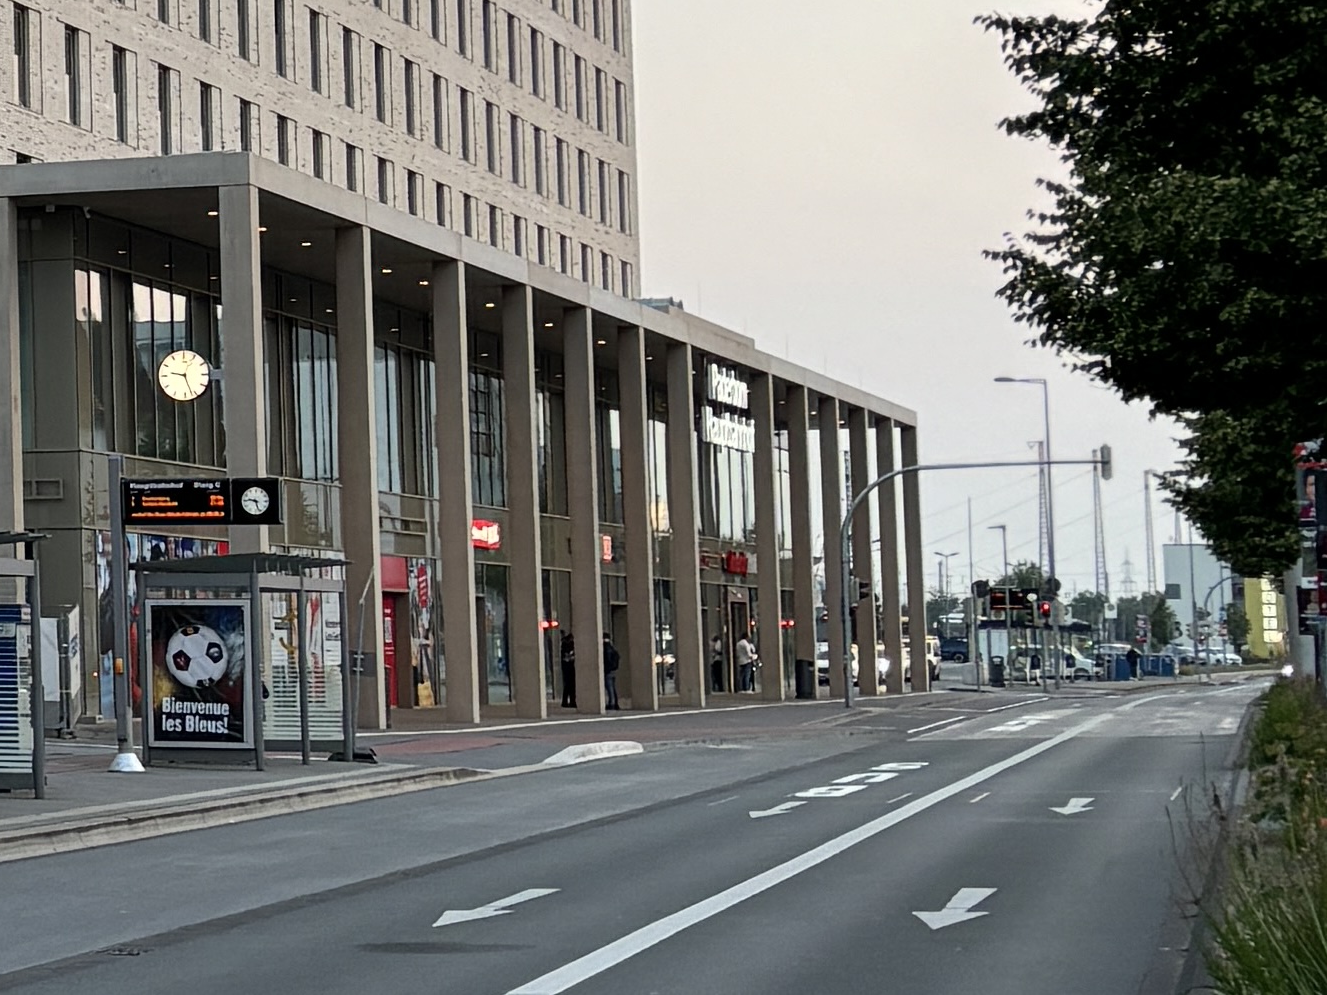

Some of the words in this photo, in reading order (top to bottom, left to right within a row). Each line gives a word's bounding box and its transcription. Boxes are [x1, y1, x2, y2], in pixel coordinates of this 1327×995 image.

[162, 696, 230, 715] Bienvenue
[162, 714, 182, 732] les
[185, 715, 229, 734] Bleus!
